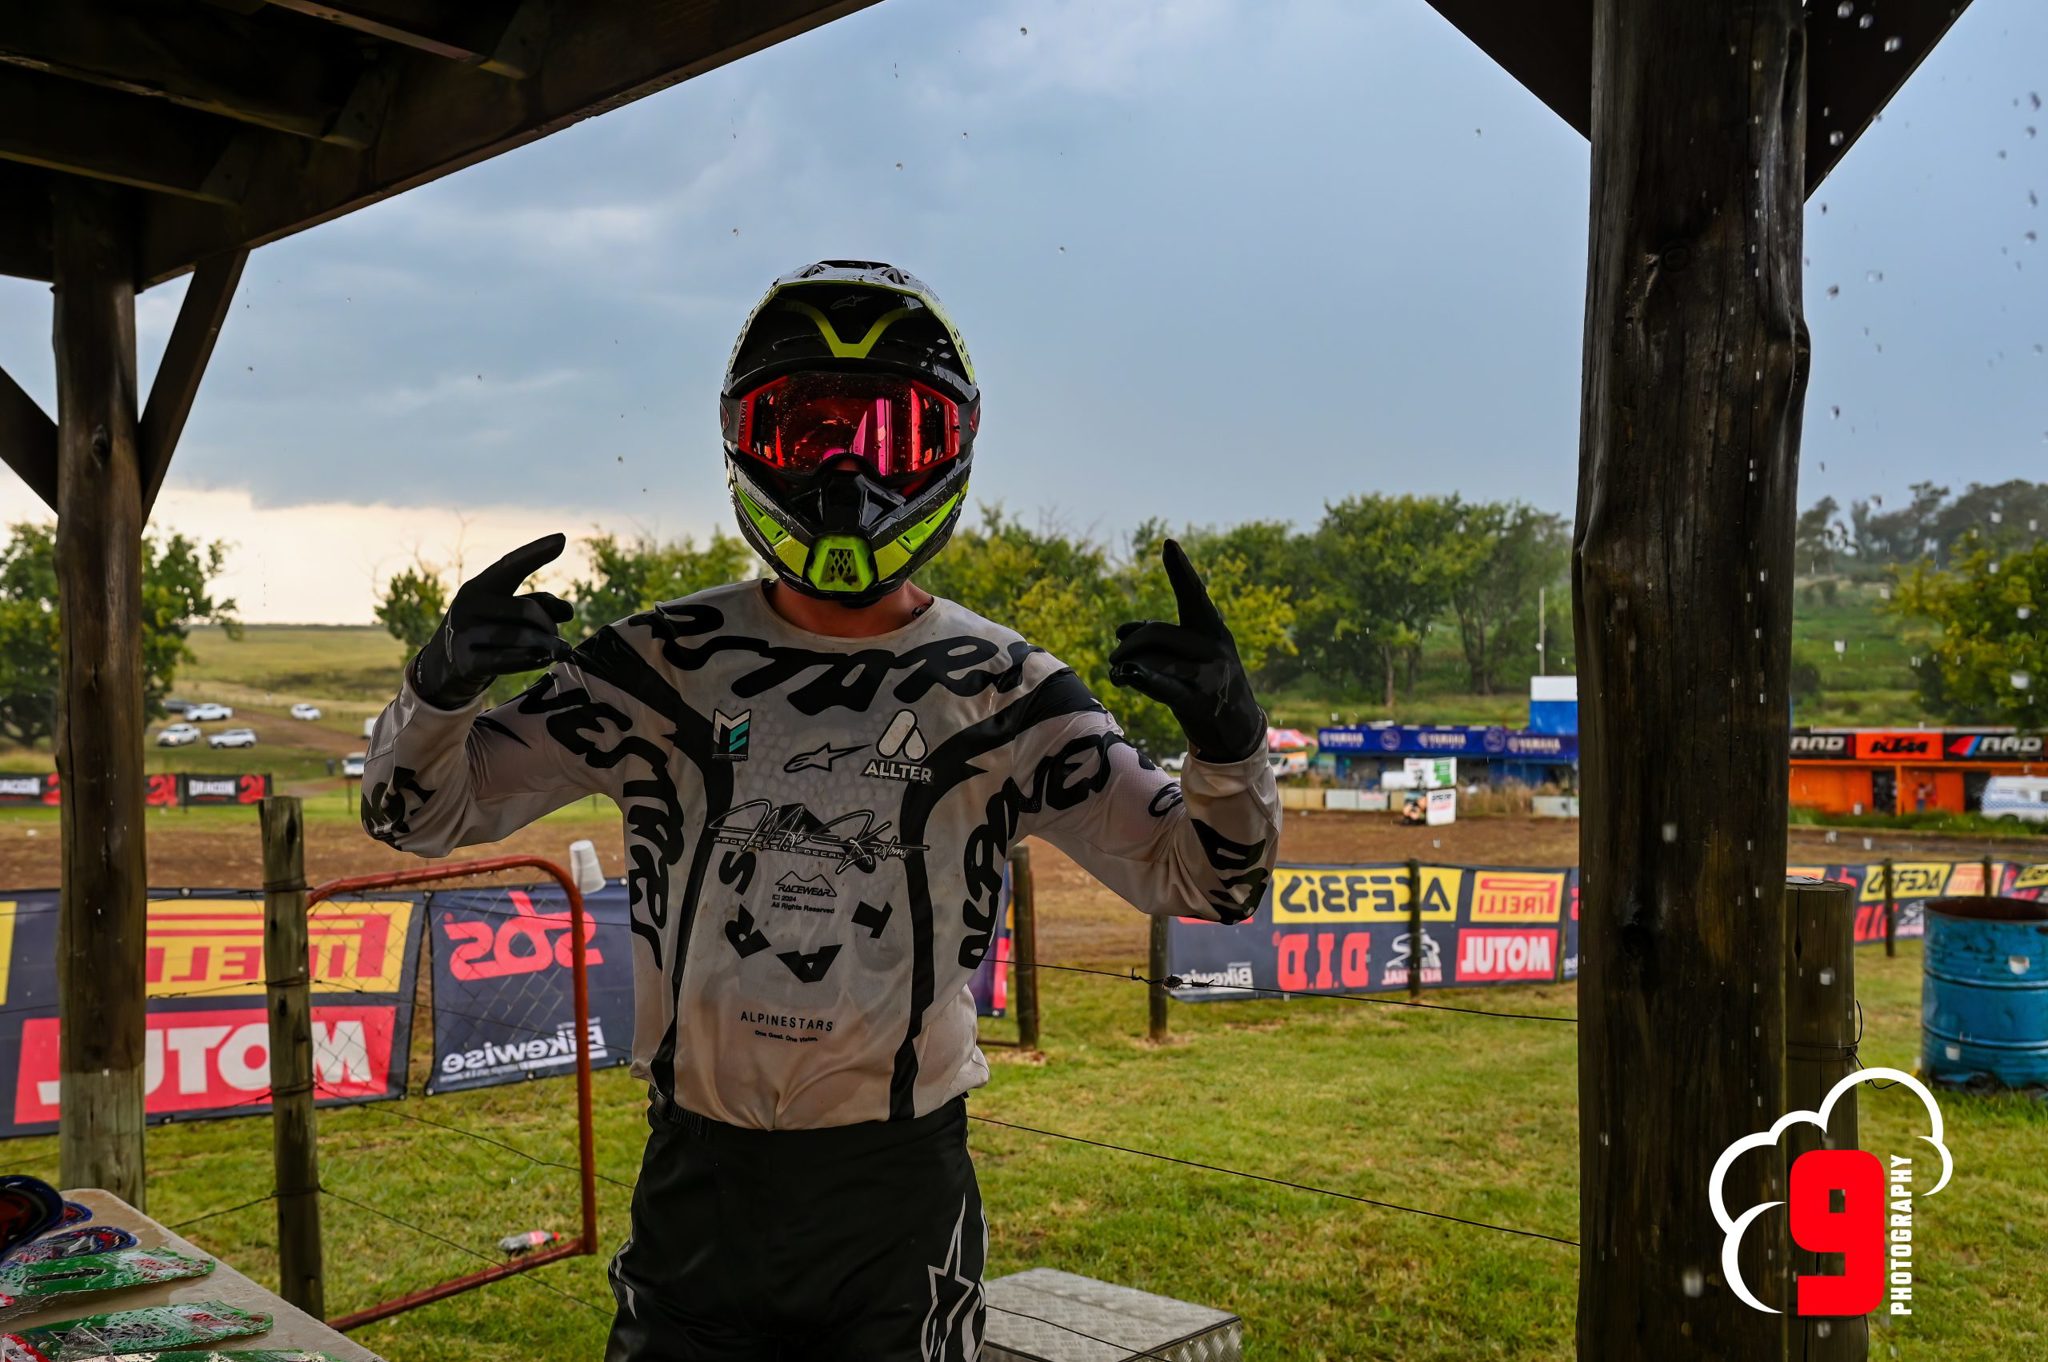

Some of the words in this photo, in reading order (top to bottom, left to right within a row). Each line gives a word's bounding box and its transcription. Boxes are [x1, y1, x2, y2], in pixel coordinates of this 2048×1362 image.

[1870, 736, 1928, 753] KTM
[864, 761, 932, 783] ALLTER
[777, 884, 831, 897] RACEWEAR
[781, 903, 802, 911] Rights
[803, 905, 835, 914] Reserved
[741, 1011, 833, 1032] ALPINESTARS
